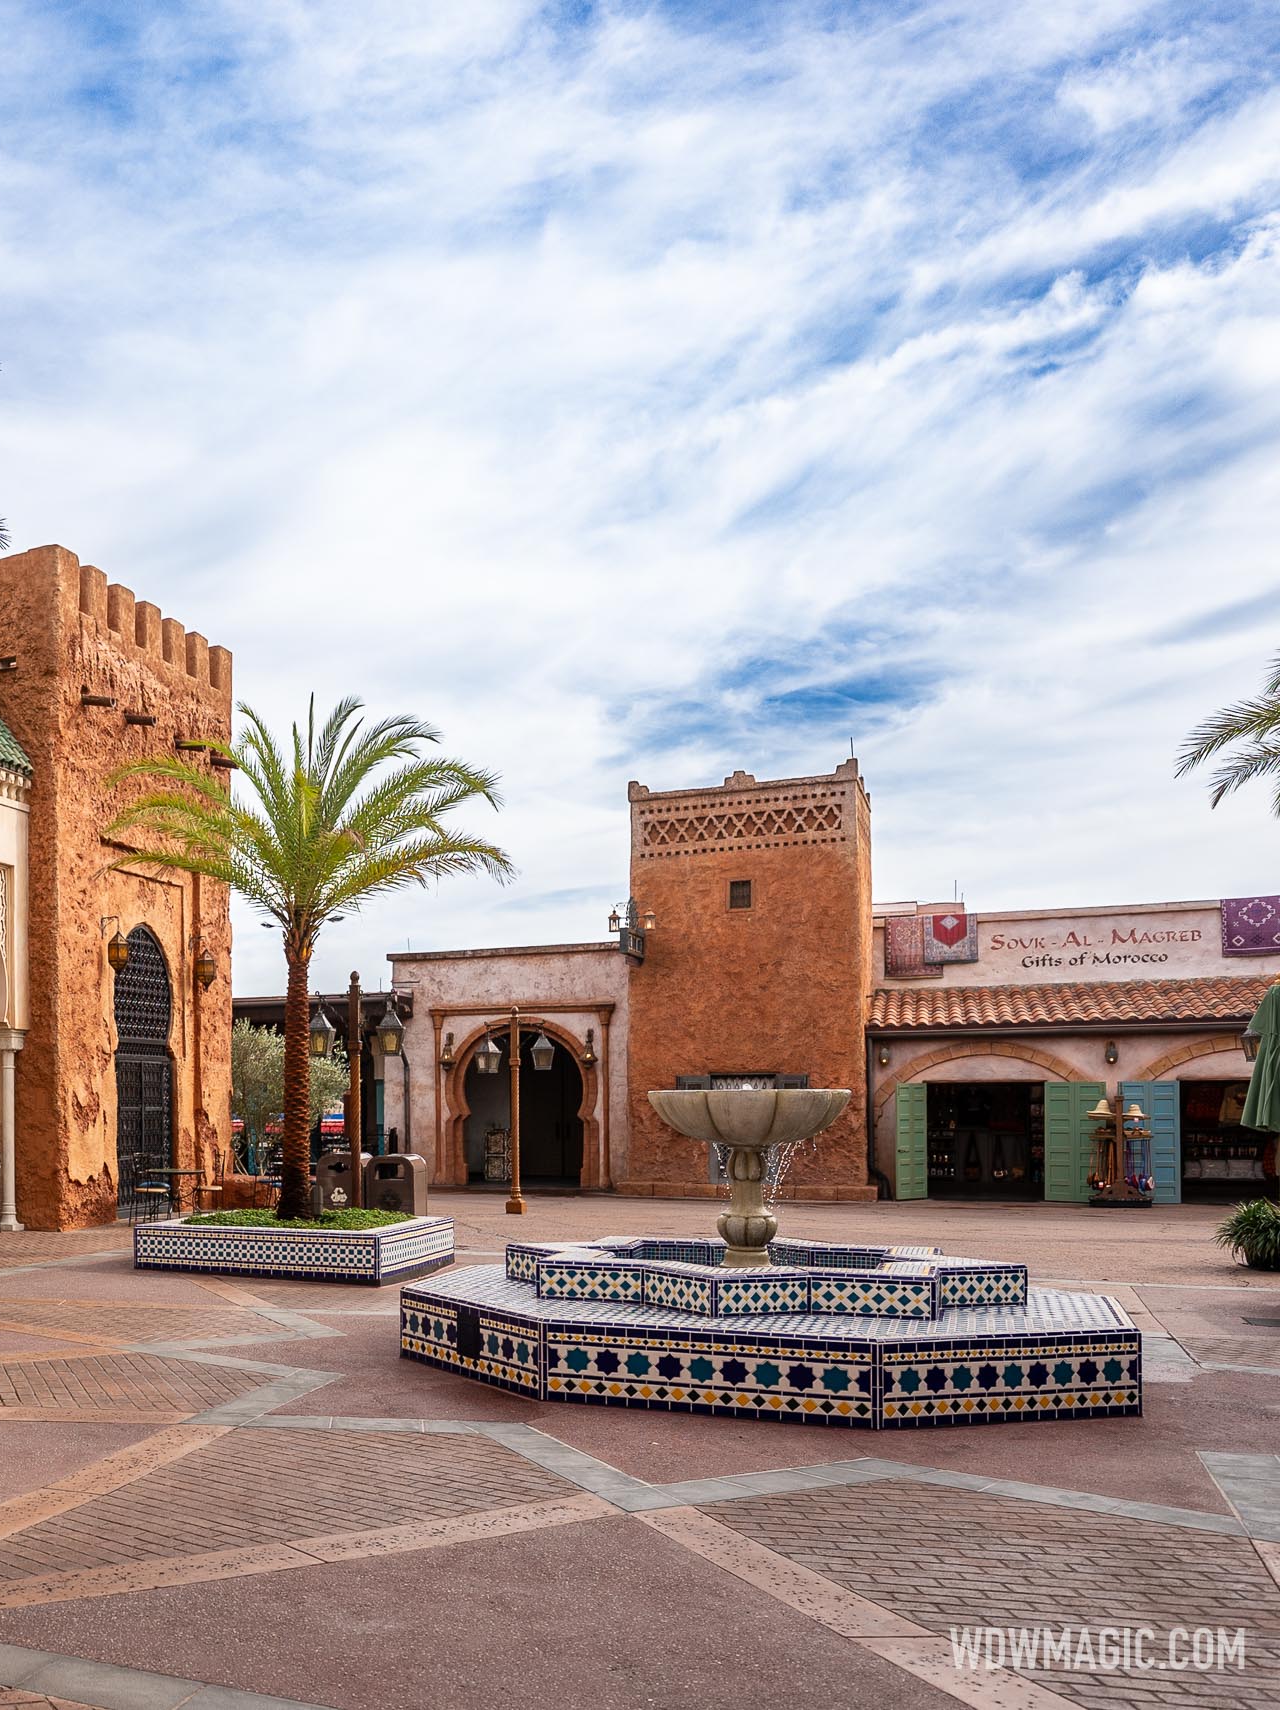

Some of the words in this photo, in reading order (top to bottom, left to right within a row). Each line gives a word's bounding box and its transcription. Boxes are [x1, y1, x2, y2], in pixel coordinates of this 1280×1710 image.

[1021, 953, 1063, 968] Gifts
[1068, 951, 1088, 966] of
[1092, 952, 1169, 965] Morocco
